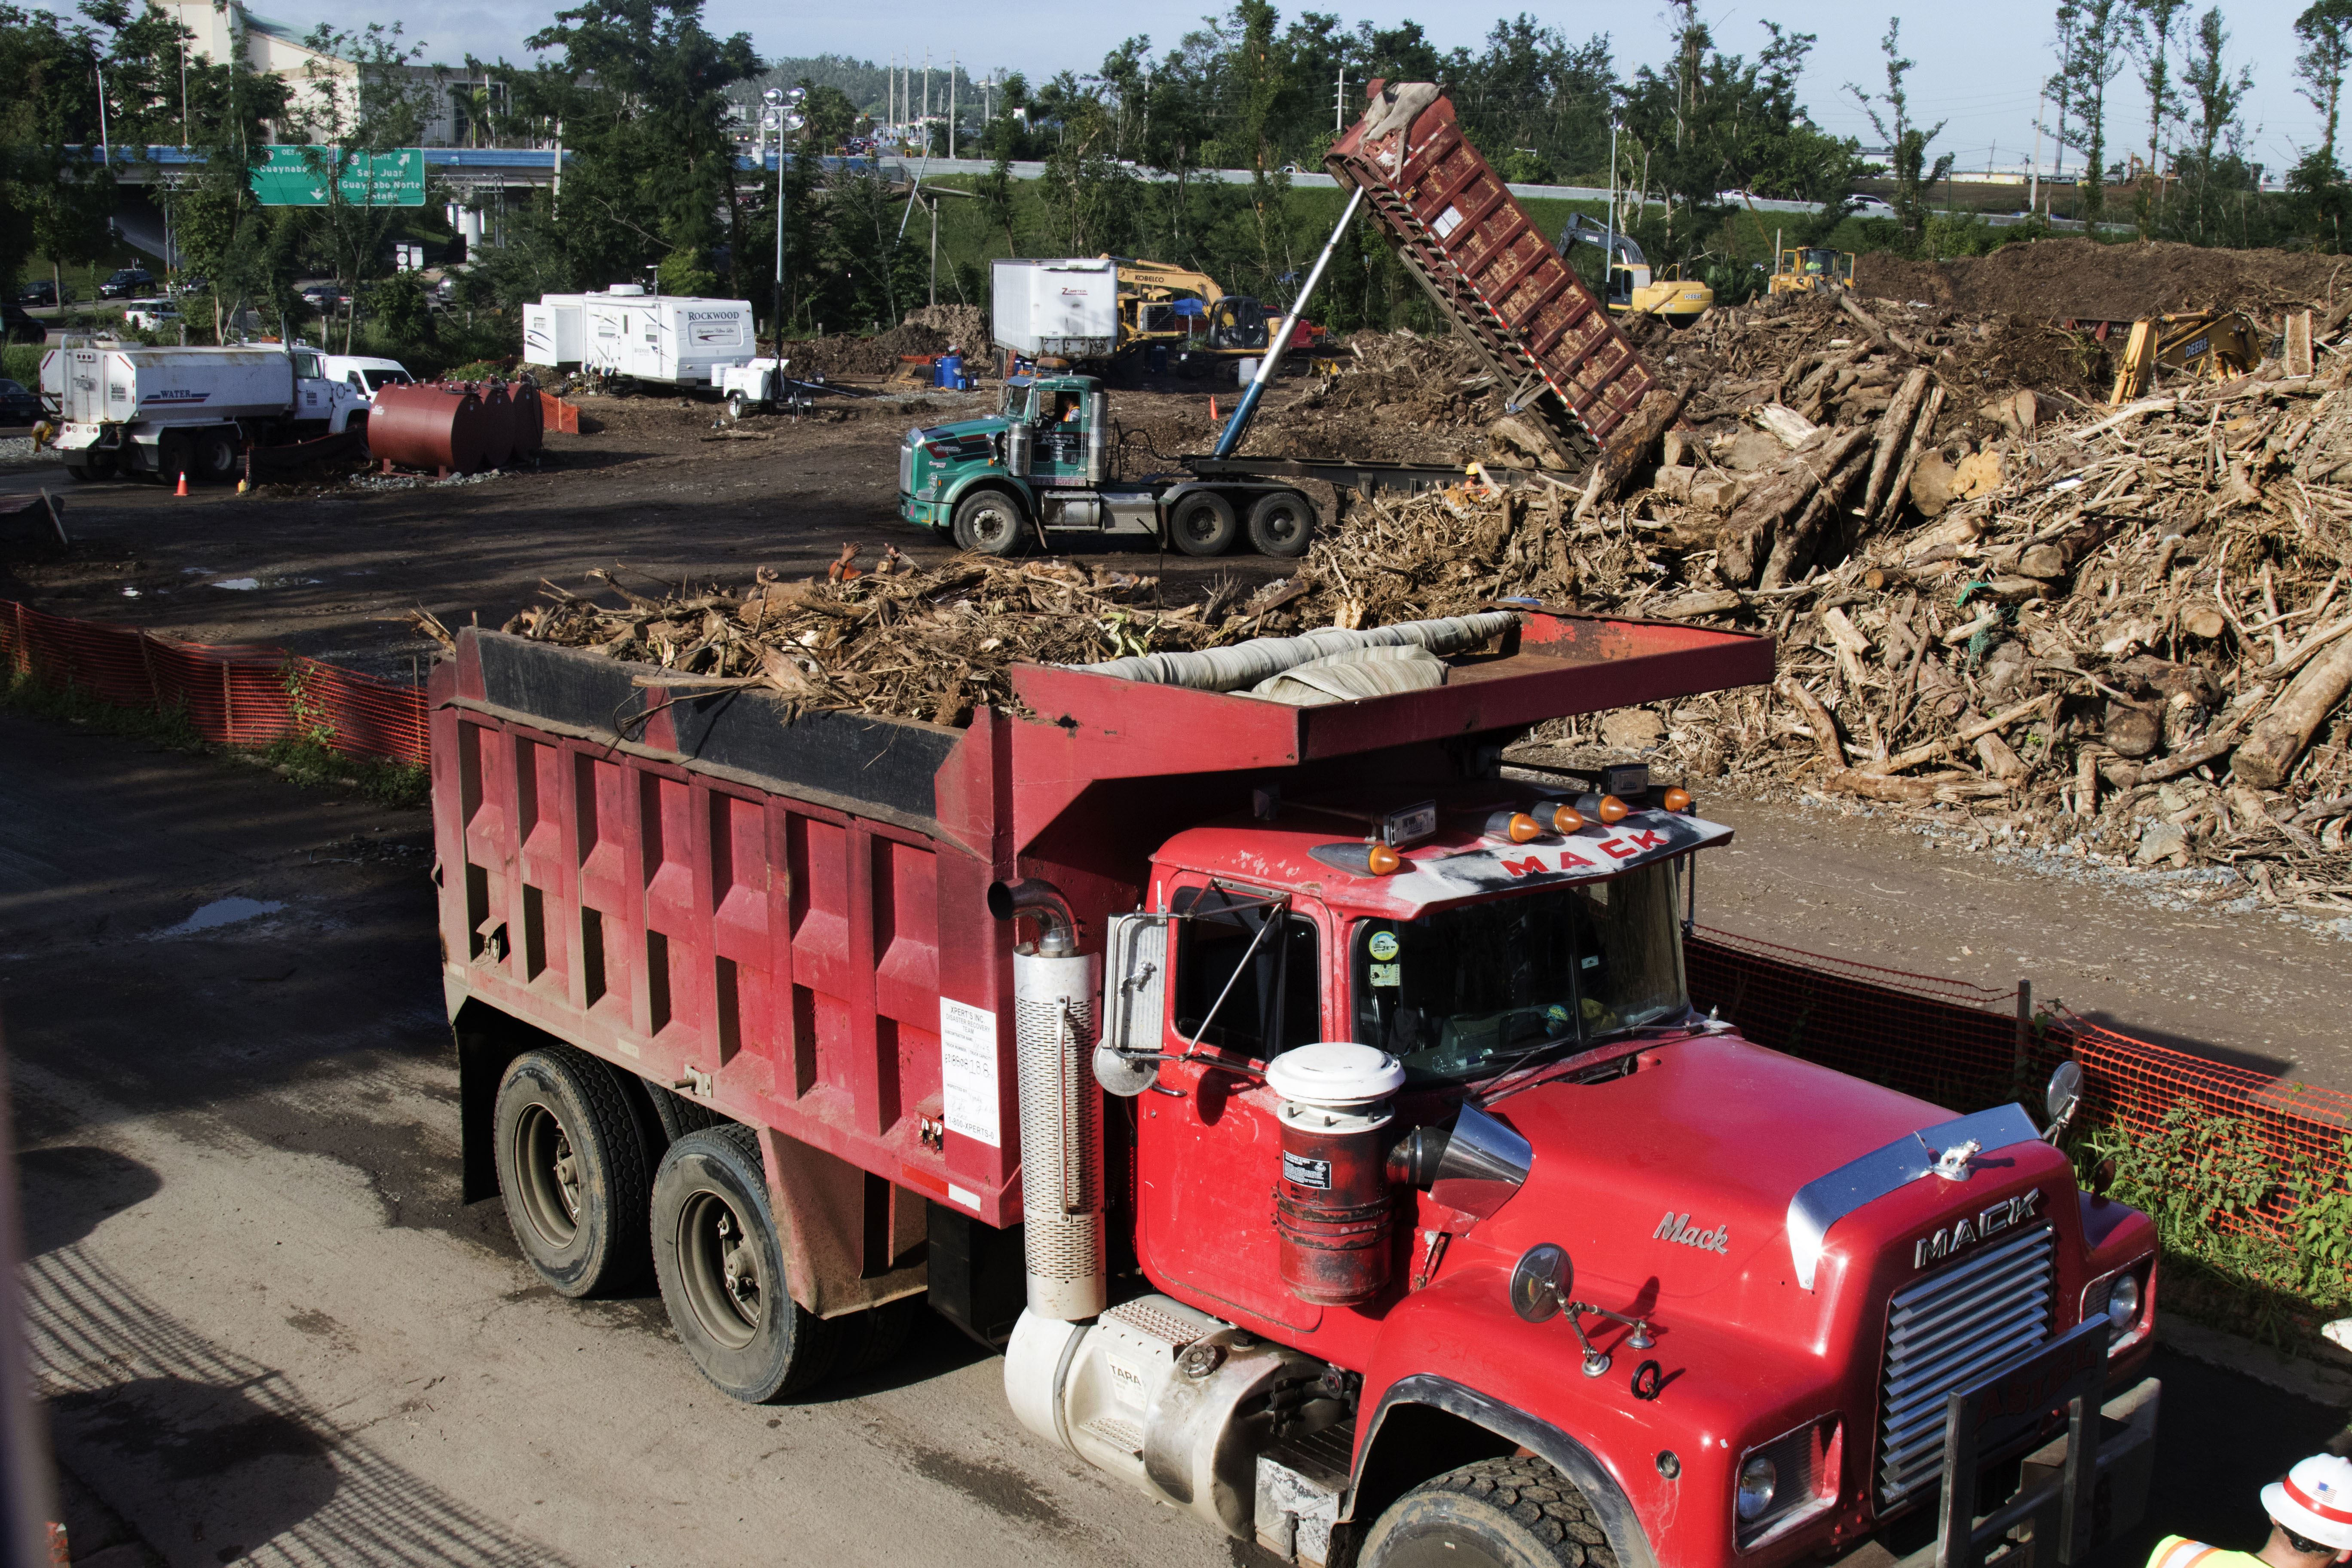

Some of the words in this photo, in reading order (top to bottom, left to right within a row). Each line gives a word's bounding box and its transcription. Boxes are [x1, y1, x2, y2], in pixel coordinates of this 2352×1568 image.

[342, 181, 390, 190] Guayabo
[1135, 274, 1164, 283] KOBELCO
[688, 312, 739, 320] ROCKWOOD
[2186, 337, 2208, 358] DEERE
[160, 389, 191, 398] WATER
[1500, 829, 1668, 877] MACK
[946, 1013, 966, 1026] DISASTER
[967, 1020, 990, 1033] RECOVERY
[950, 1005, 973, 1020] XPERT'S
[974, 1013, 985, 1024] INC.
[962, 1025, 974, 1035] TEAM
[946, 1082, 962, 1092] INSPECTED
[948, 1115, 994, 1140] 1-800-XPERTS-0
[1653, 1211, 1728, 1254] Mack
[1915, 1187, 2039, 1268] MACK
[1110, 1364, 1141, 1386] TARA
